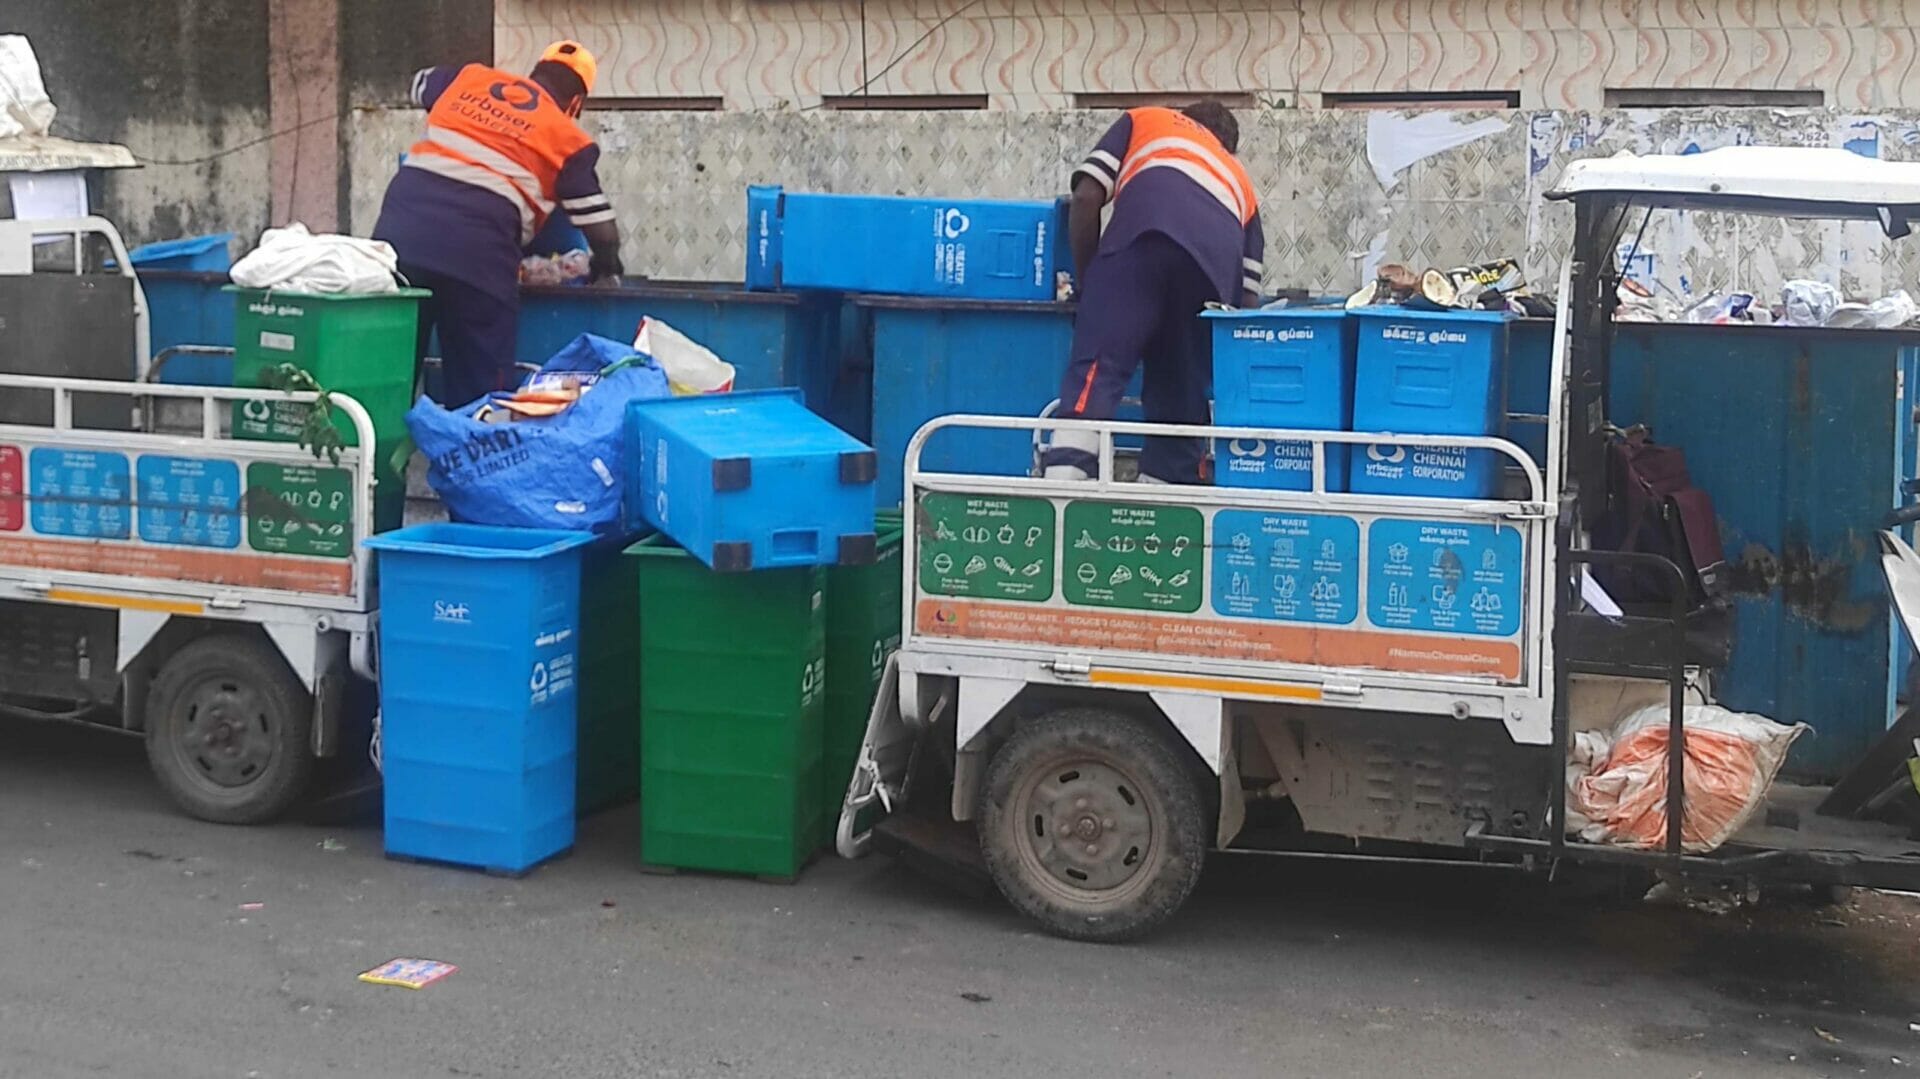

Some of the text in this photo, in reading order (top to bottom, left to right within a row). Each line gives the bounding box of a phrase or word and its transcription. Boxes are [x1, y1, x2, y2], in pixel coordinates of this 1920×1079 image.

[460, 92, 533, 131] urbaser
[1274, 445, 1313, 457] CHENN
[477, 449, 530, 477] LIMITED
[1274, 458, 1312, 472] CORPORAT
[1413, 452, 1466, 468] CHENNAI
[1412, 465, 1465, 482] CORPORATION
